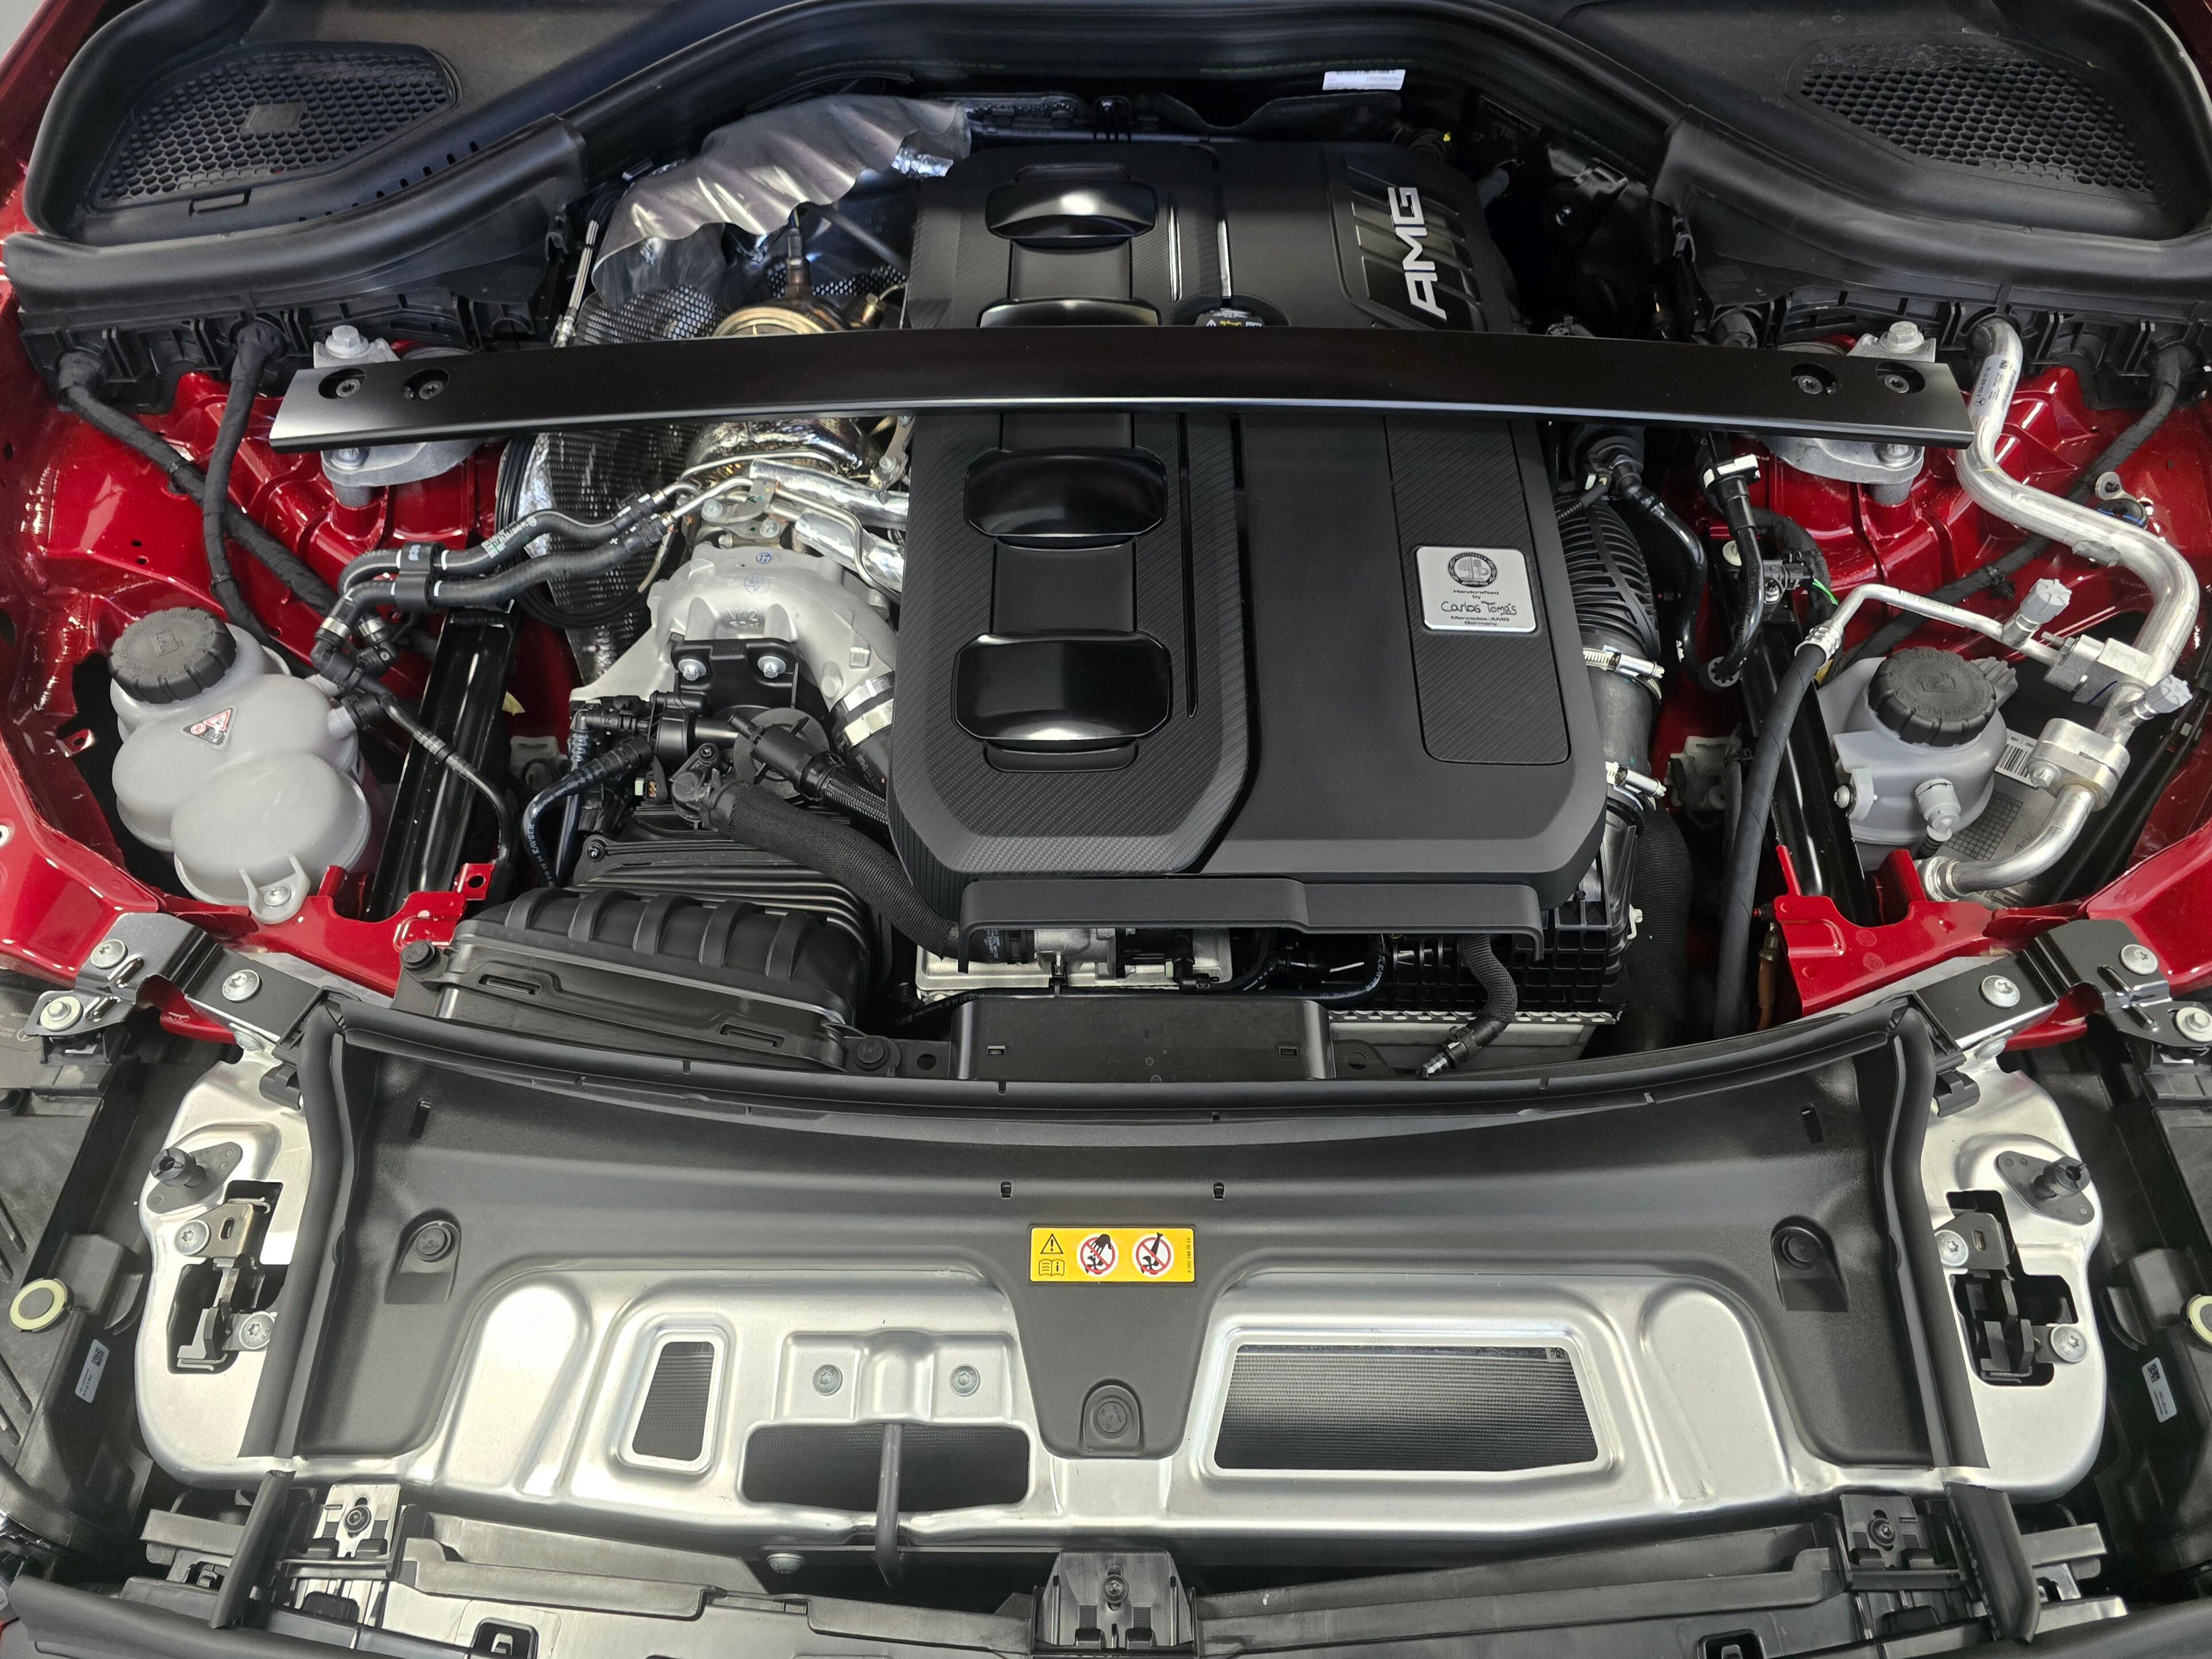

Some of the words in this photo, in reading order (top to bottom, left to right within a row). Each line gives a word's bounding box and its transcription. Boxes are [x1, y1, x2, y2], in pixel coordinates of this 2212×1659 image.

[1387, 187, 1447, 321] AMG
[1440, 601, 1481, 613] Carlos
[1481, 601, 1517, 616] Tomás
[528, 824, 539, 854] KAYSER
